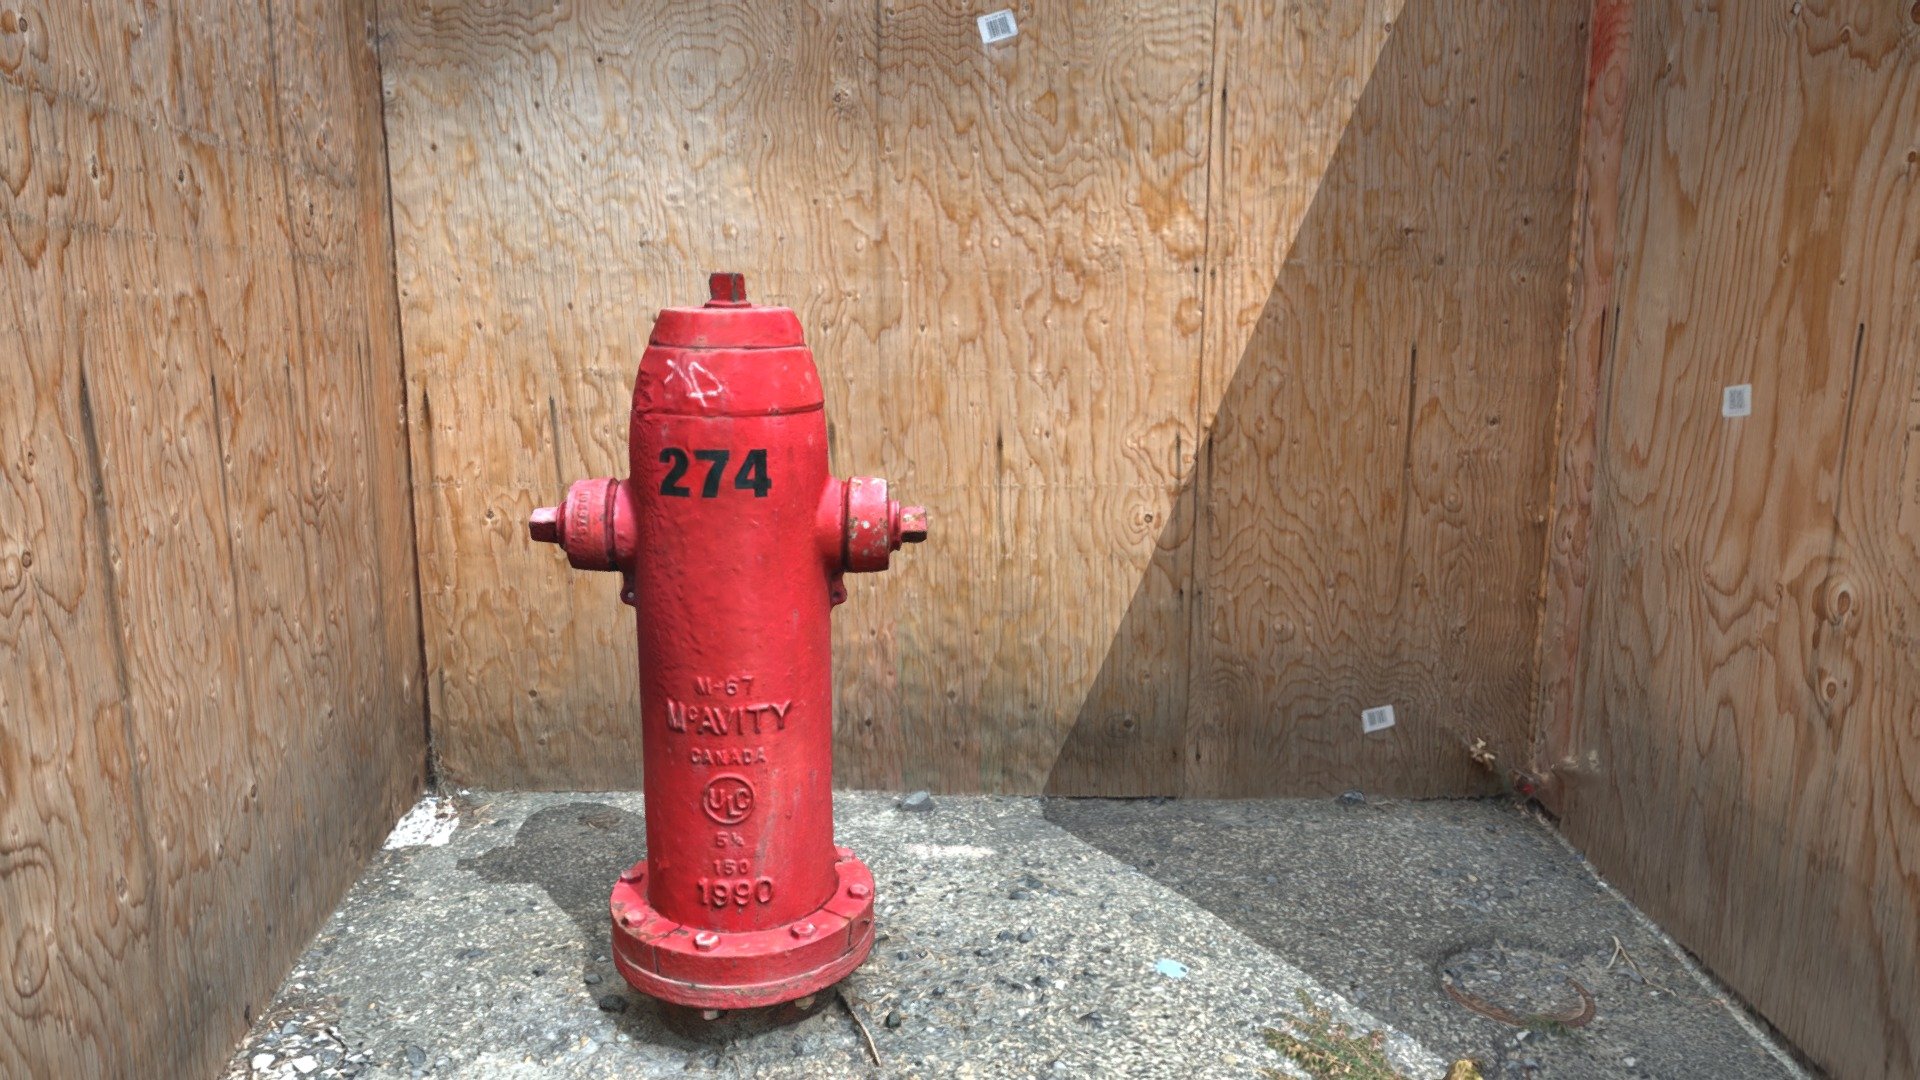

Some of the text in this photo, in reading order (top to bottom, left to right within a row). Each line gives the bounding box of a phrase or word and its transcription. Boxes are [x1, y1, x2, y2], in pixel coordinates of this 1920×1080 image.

[659, 447, 772, 498] 274
[694, 674, 755, 696] M-67
[691, 747, 768, 766] CANADA
[712, 858, 750, 876] 150
[697, 876, 774, 907] 1990
